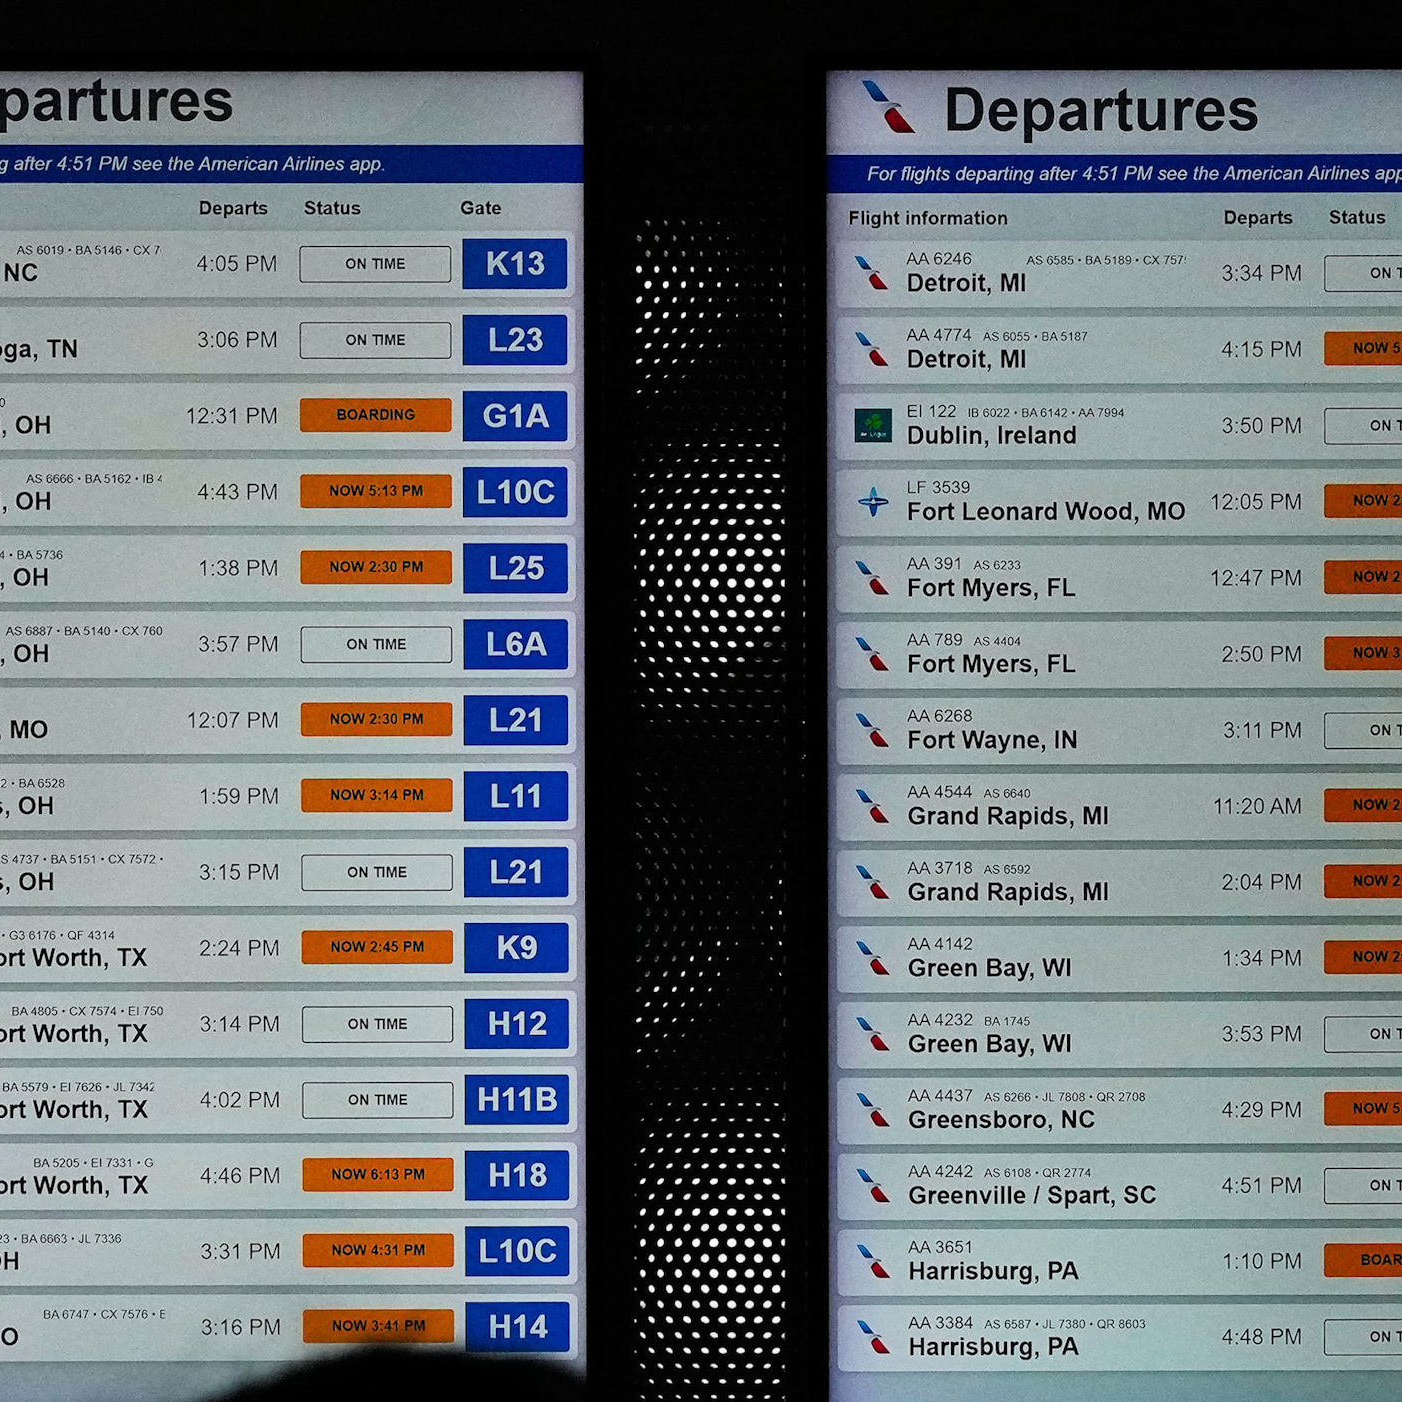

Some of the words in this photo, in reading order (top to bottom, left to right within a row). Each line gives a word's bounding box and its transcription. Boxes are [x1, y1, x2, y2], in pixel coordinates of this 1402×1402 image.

[946, 86, 1258, 144] Departures
[4, 262, 38, 282] NC
[196, 254, 239, 272] 4:05
[245, 254, 277, 272] PM
[345, 257, 367, 270] ON
[371, 257, 405, 270] TIME
[487, 250, 545, 276] K13
[1222, 264, 1263, 282] 3:34
[1270, 263, 1302, 282] PM
[907, 272, 992, 295] Detroit,
[1000, 272, 1026, 292] MI
[46, 338, 78, 358] TN
[489, 327, 544, 352] L23
[187, 407, 237, 425] 12:31
[246, 406, 278, 424] PM
[336, 408, 416, 421] BOARDING
[483, 403, 550, 428] G1A
[906, 404, 923, 419] EI
[929, 403, 957, 419] 122
[15, 415, 51, 435] OH
[908, 425, 989, 448] Dublin,
[998, 425, 1077, 445] Ireland
[329, 484, 365, 497] NOW
[368, 484, 397, 497] 5:13
[401, 484, 423, 496] PM
[477, 479, 555, 504] L10C
[906, 480, 926, 495] LF
[932, 480, 971, 495] 3539
[908, 501, 955, 521] Fort
[962, 501, 1058, 521] Leonard
[1065, 501, 1139, 524] Wood,
[1147, 501, 1186, 521] MO
[13, 567, 49, 587] OH
[489, 555, 545, 581] L25
[1211, 569, 1263, 587] 12:47
[1270, 569, 1302, 586] PM
[487, 631, 548, 657] L6A
[10, 719, 48, 739] MO
[490, 707, 541, 732] L21
[908, 730, 955, 750] Fort
[961, 729, 1046, 754] Wayne,
[1054, 729, 1077, 749] IN
[330, 788, 366, 801] NOW
[369, 788, 398, 801] 3:14
[402, 788, 424, 801] PM
[1213, 797, 1266, 815] 11:20
[1270, 797, 1303, 815] AM
[908, 806, 979, 826] Grand
[987, 806, 1074, 830] Rapids,
[1083, 805, 1109, 825] MI
[497, 934, 538, 960] K9
[908, 958, 978, 978] Green
[986, 957, 1035, 982] Bay,
[1042, 957, 1071, 977] WI
[488, 1010, 547, 1036] H12
[478, 1086, 558, 1112] H11B
[908, 1109, 1053, 1132] Greensboro,
[1061, 1109, 1095, 1129] NC
[489, 1162, 548, 1188] H18
[909, 1261, 1039, 1286] Harrisburg,
[1048, 1260, 1079, 1280] PA
